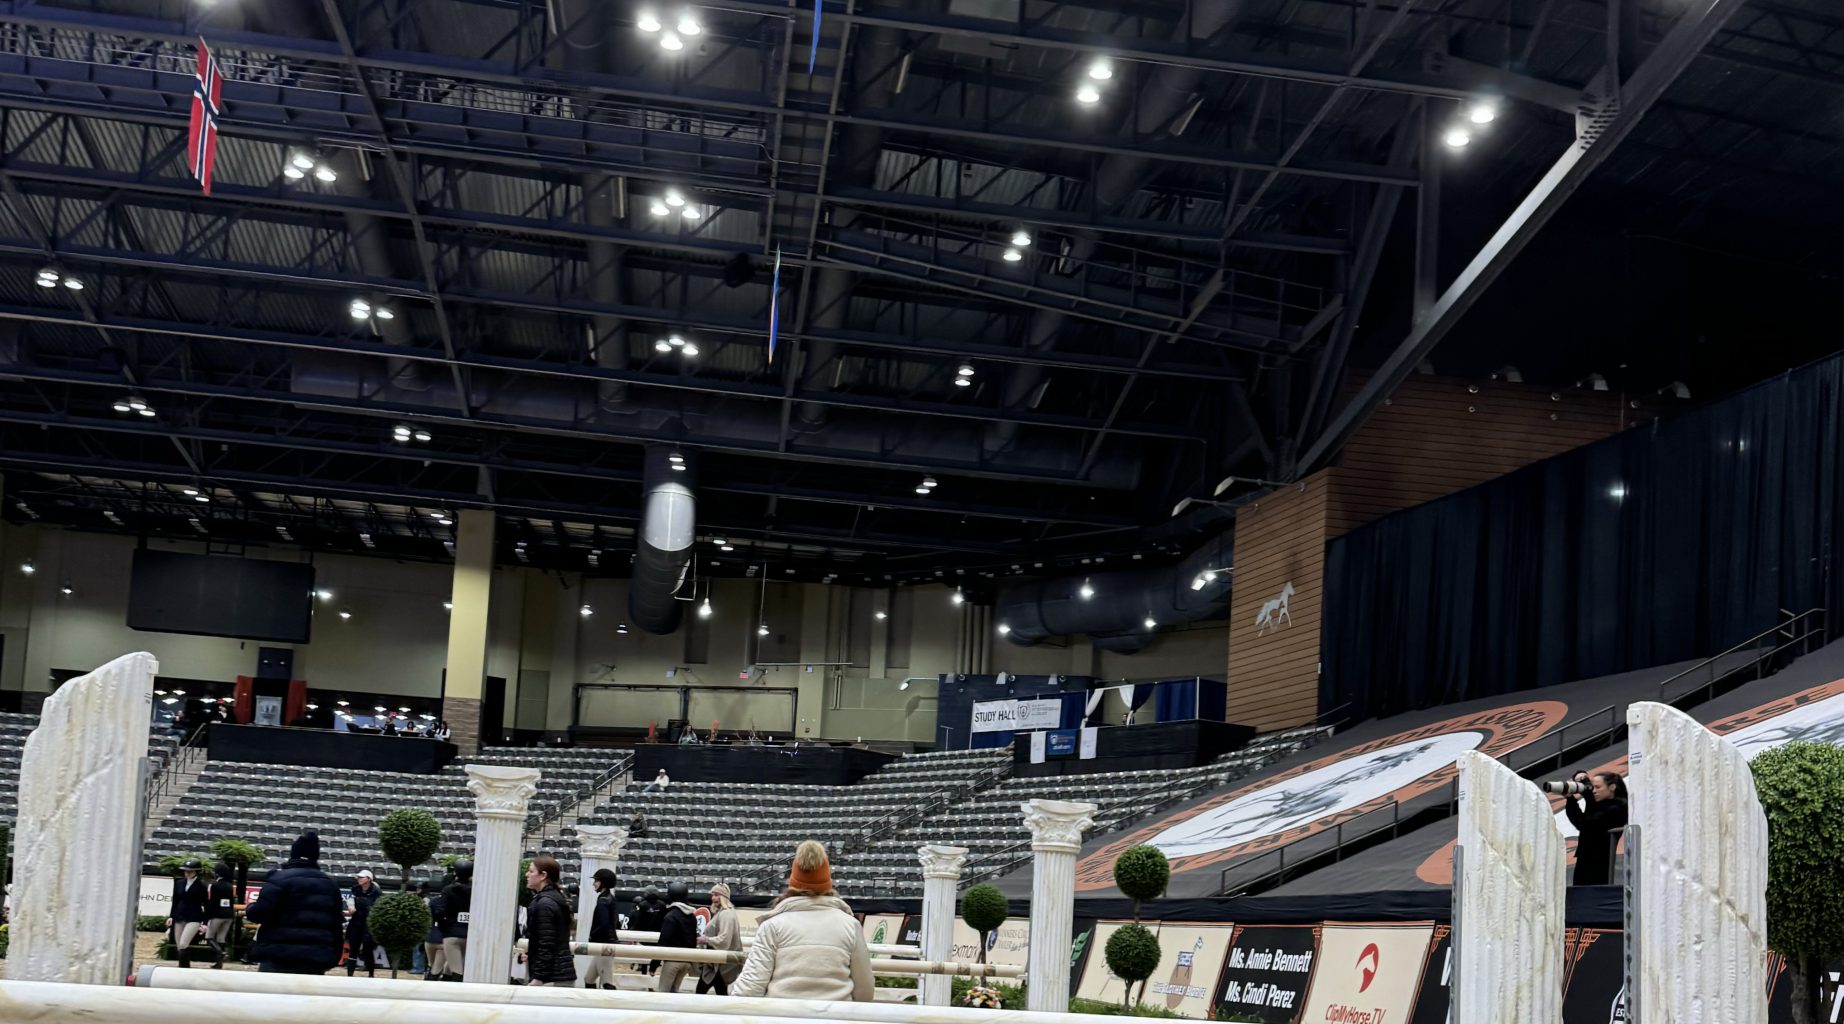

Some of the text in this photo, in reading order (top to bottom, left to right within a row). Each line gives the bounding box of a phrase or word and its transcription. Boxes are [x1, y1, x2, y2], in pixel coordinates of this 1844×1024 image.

[974, 710, 996, 723] STUDY
[998, 708, 1017, 721] HALL
[1228, 947, 1313, 973] Ms. Annie Bennett
[1225, 980, 1296, 1009] Ms. Cindi Perez
